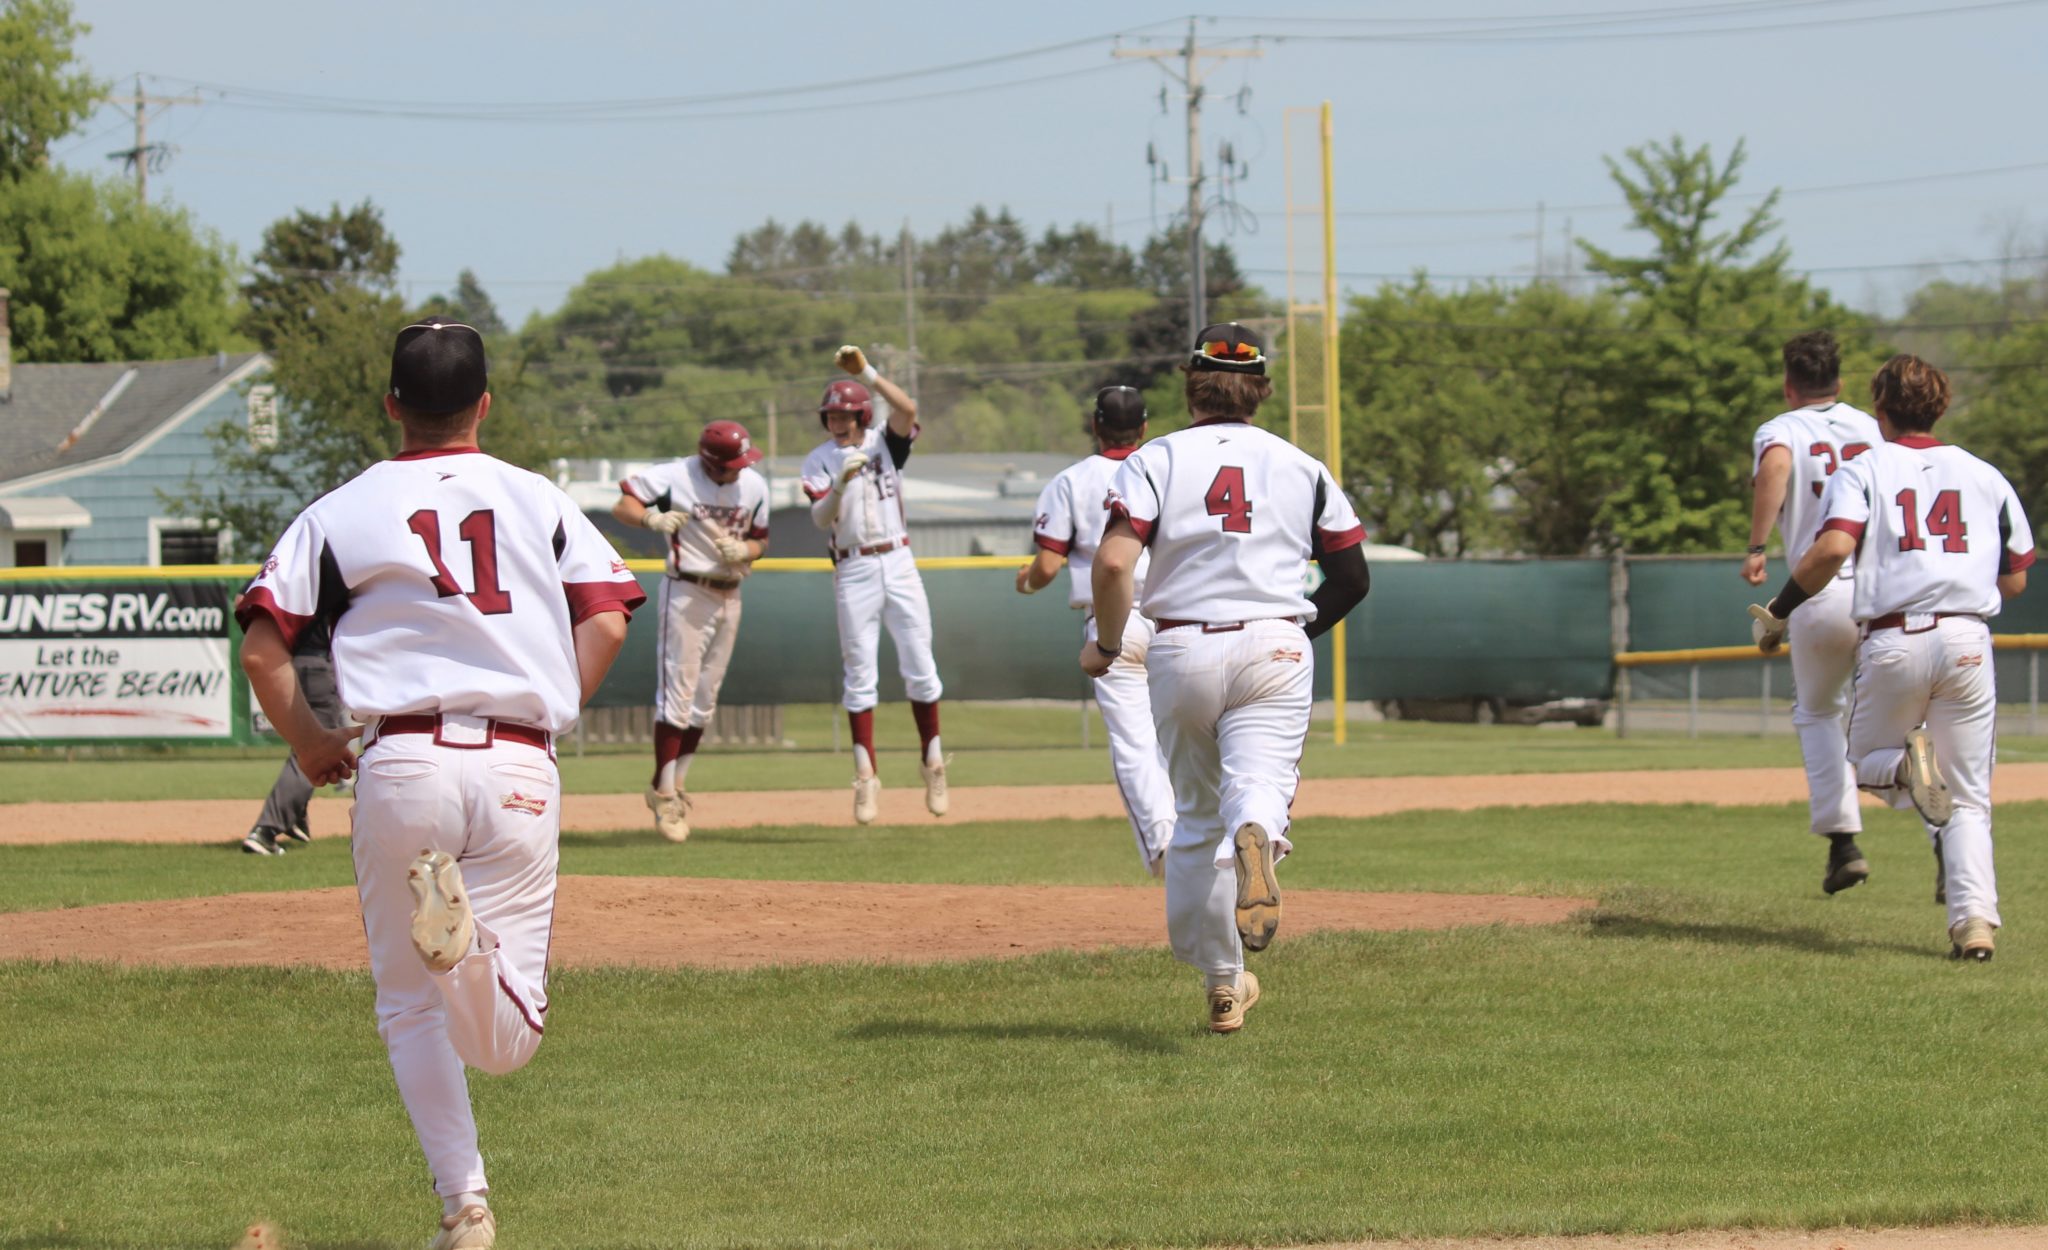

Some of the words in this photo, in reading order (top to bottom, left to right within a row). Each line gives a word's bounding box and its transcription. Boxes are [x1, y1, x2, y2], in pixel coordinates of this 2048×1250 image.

[1204, 465, 1252, 533] 4
[1896, 488, 1969, 553] 14
[407, 509, 512, 615] 11
[37, 647, 74, 666] Let
[82, 647, 120, 665] the
[117, 671, 224, 698] BEGIN!
